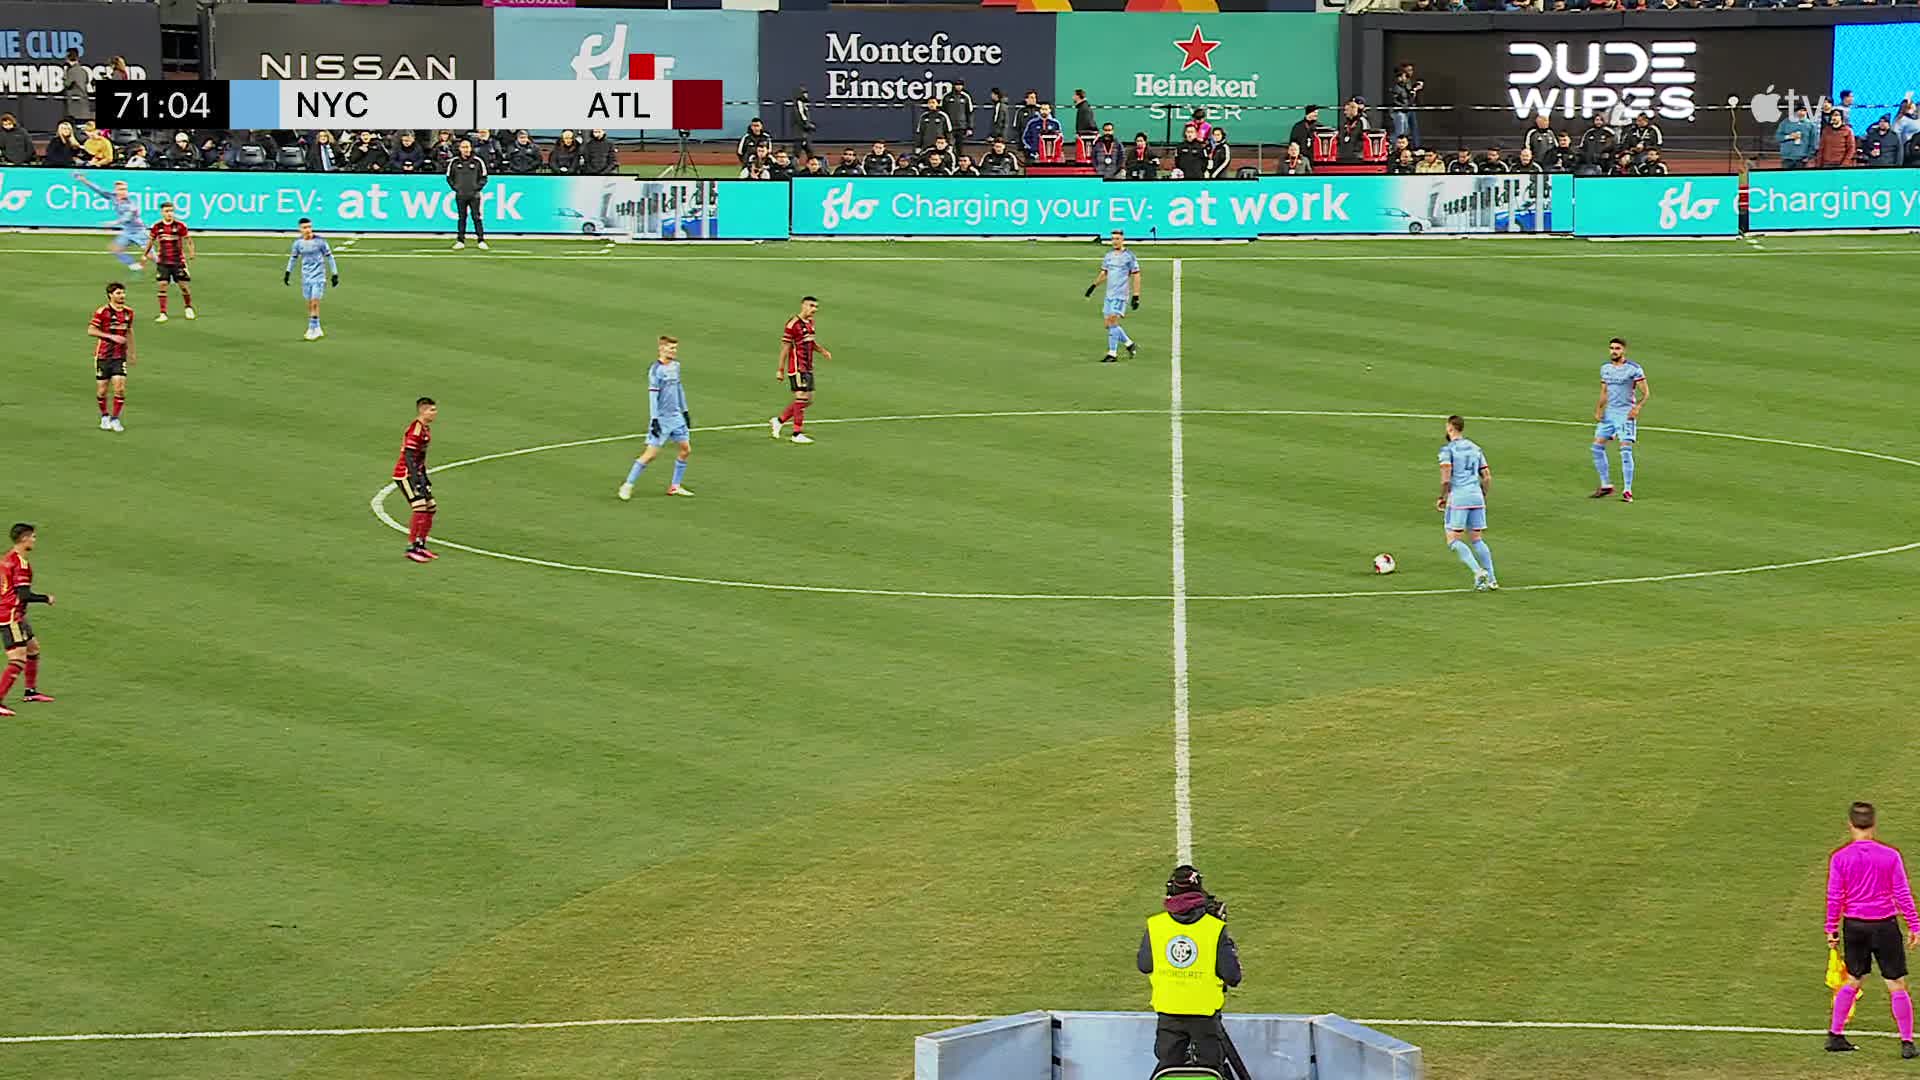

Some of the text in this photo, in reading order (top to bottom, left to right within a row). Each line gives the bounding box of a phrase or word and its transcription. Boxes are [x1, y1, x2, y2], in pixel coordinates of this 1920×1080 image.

[26, 31, 84, 58] CLUB
[826, 33, 1002, 63] Montefiore
[261, 54, 457, 80] NISSAN
[1508, 42, 1697, 84] DUDE
[826, 70, 953, 99] Einstein
[1134, 74, 1257, 97] Heineken
[1508, 86, 1695, 119] WIPES
[200, 190, 270, 219] your
[277, 189, 322, 213] EV:
[337, 184, 388, 219] at
[822, 182, 1350, 229] flo Charging your EV: at work
[1659, 182, 1720, 229] flo
[1733, 186, 1890, 218] Charging
